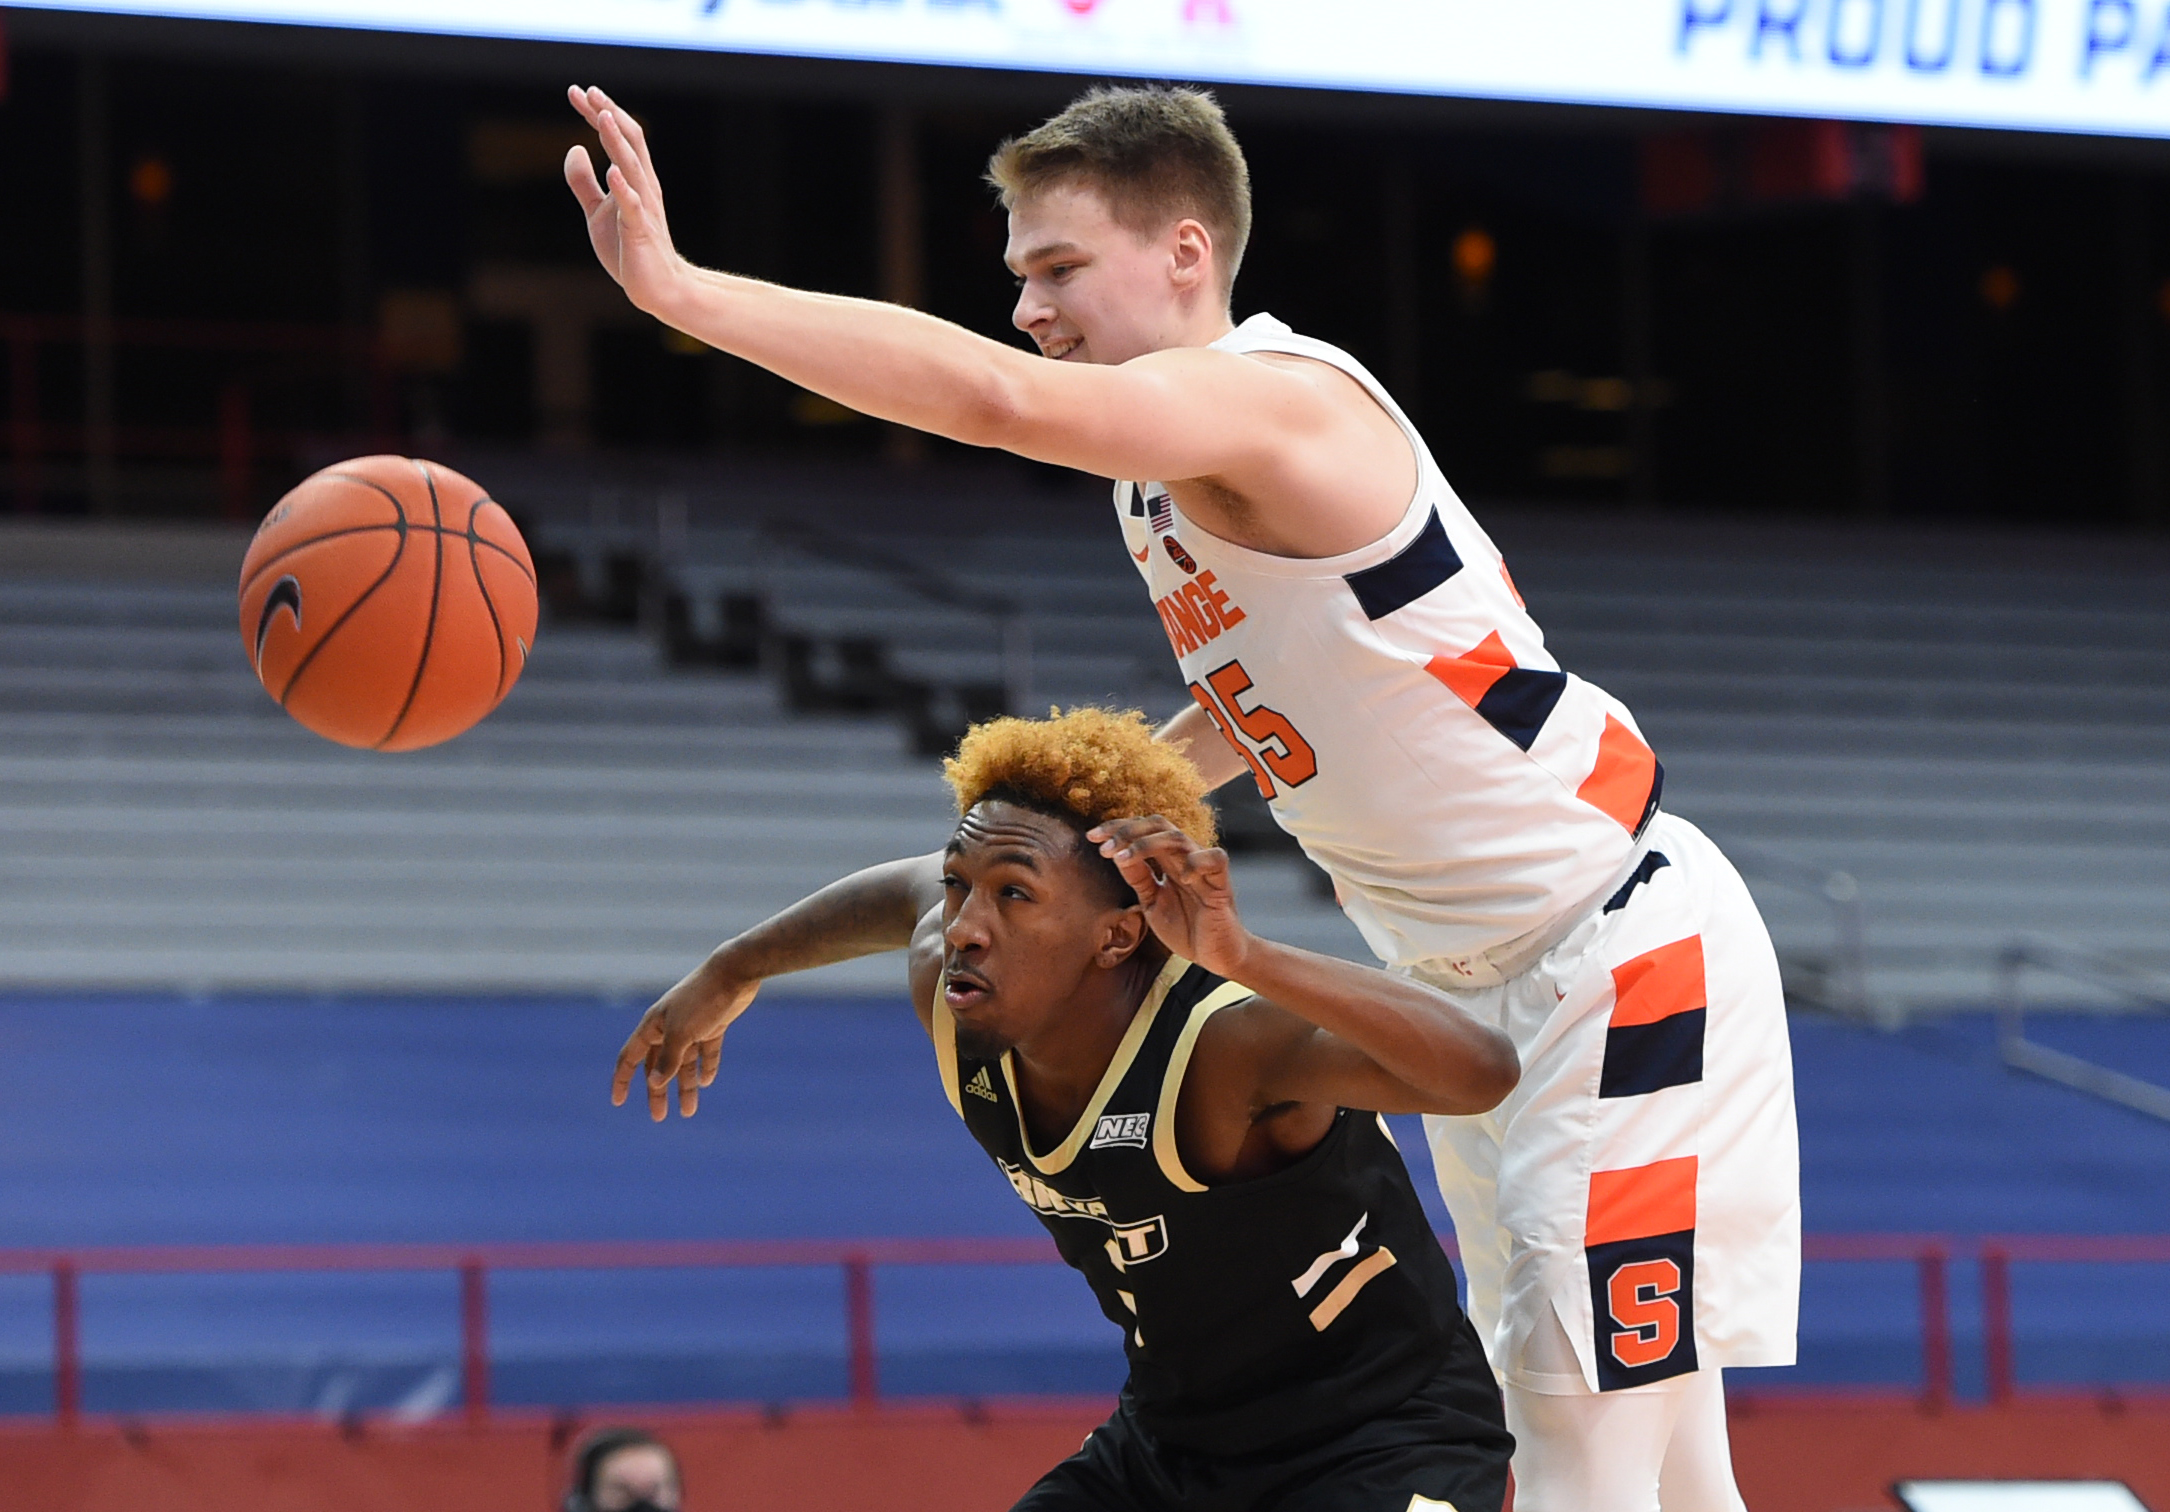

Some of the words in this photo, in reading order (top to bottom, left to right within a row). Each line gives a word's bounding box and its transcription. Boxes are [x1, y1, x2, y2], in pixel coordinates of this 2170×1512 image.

[1675, 0, 2035, 78] PROUD
[1156, 569, 1247, 659] ANGE
[965, 1084, 998, 1103] adidas
[1095, 1115, 1147, 1139] NEC
[1607, 1257, 1680, 1368] S
